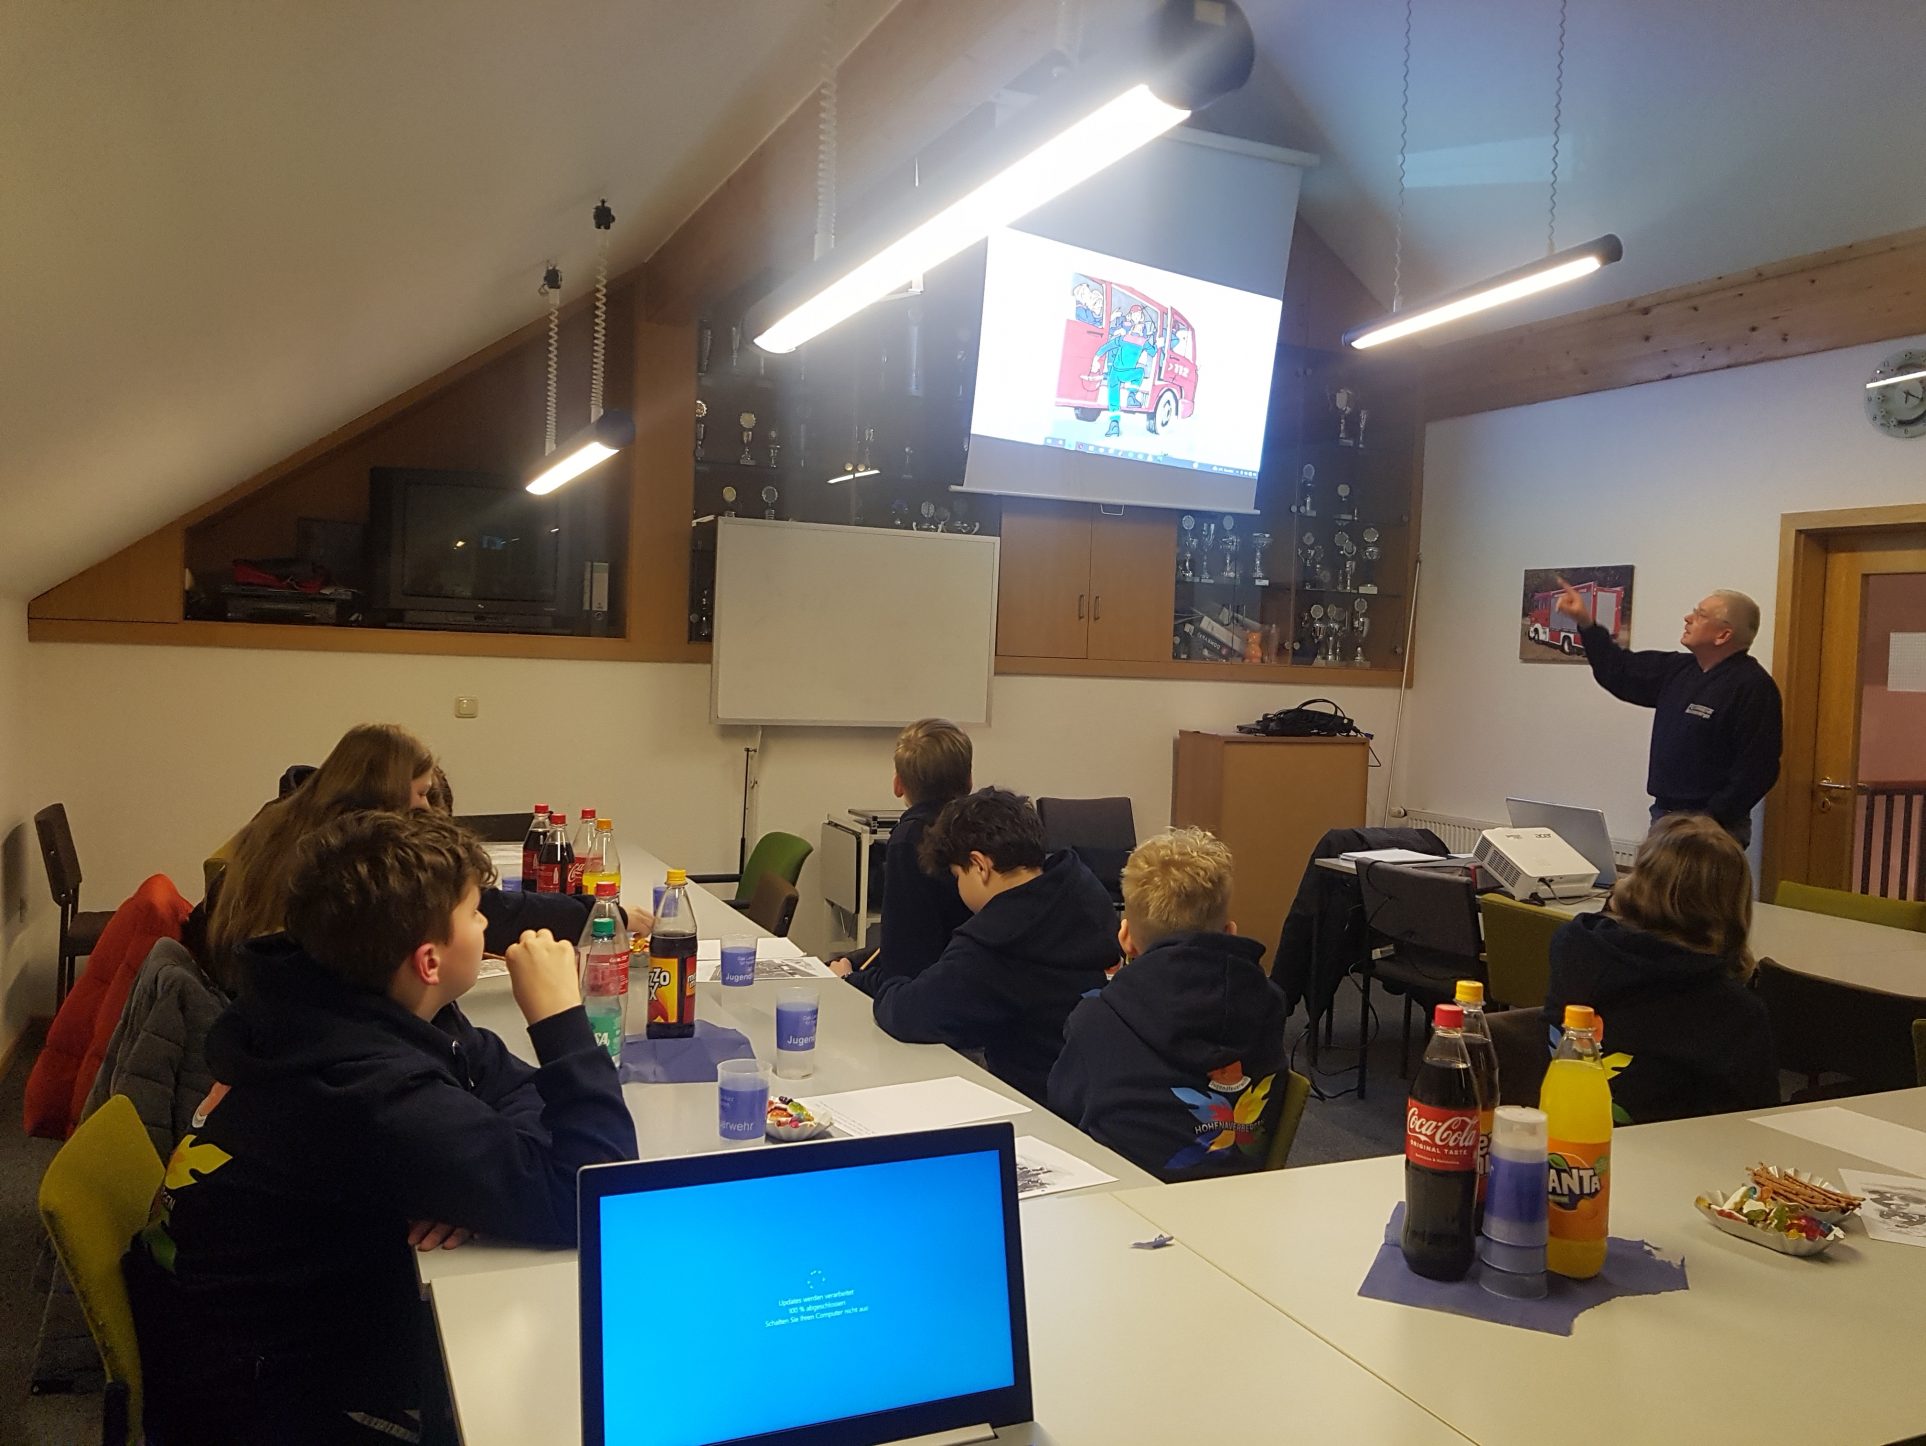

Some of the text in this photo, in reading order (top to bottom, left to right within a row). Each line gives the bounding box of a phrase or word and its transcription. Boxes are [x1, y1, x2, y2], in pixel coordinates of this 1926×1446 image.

[1407, 1107, 1478, 1147] Coca-Cola
[1548, 1168, 1601, 1195] ANTA
[779, 1298, 802, 1306] Updates
[825, 1289, 854, 1299] verarbeitet
[806, 1300, 846, 1312] abgeschlossen
[765, 1318, 789, 1327] Schalten
[815, 1309, 843, 1319] Computer
